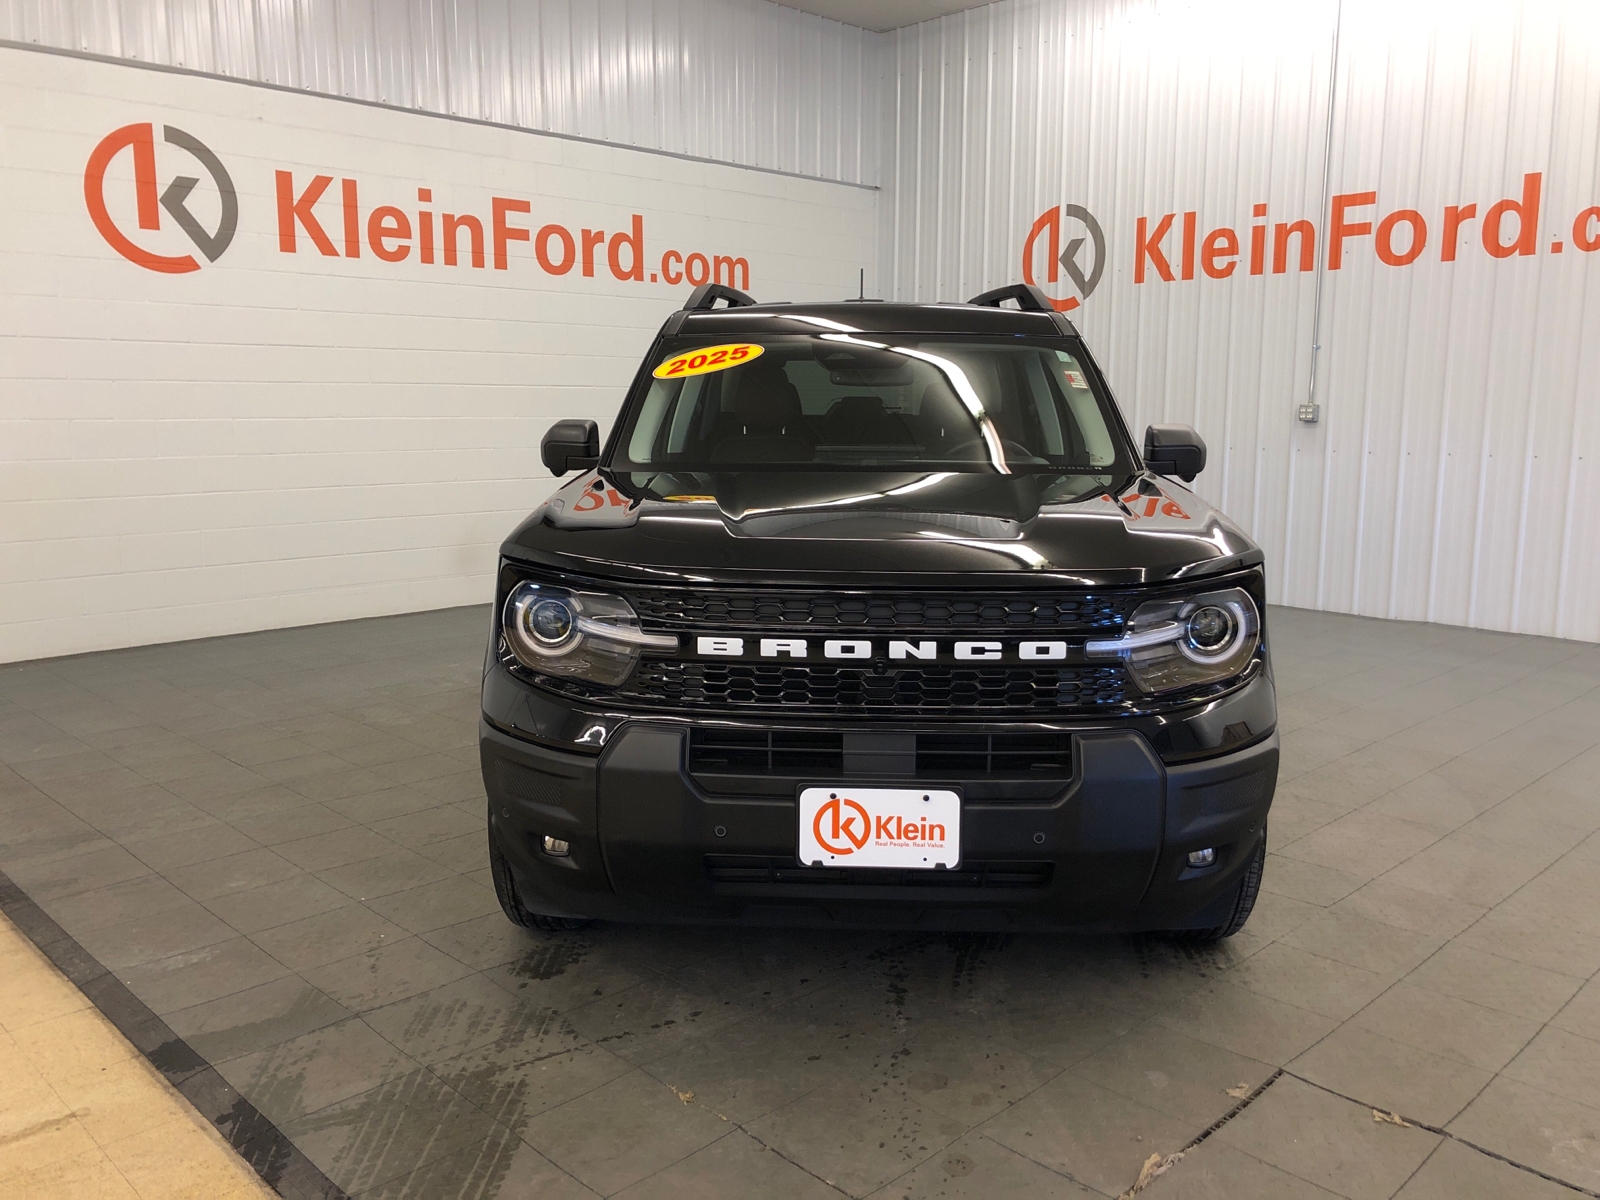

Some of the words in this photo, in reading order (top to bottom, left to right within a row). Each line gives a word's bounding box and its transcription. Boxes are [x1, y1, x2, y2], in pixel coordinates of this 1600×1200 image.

[276, 170, 750, 291] KleinFord.com
[665, 346, 751, 376] 2025
[697, 636, 1067, 660] BRONCO
[875, 816, 946, 842] Klein
